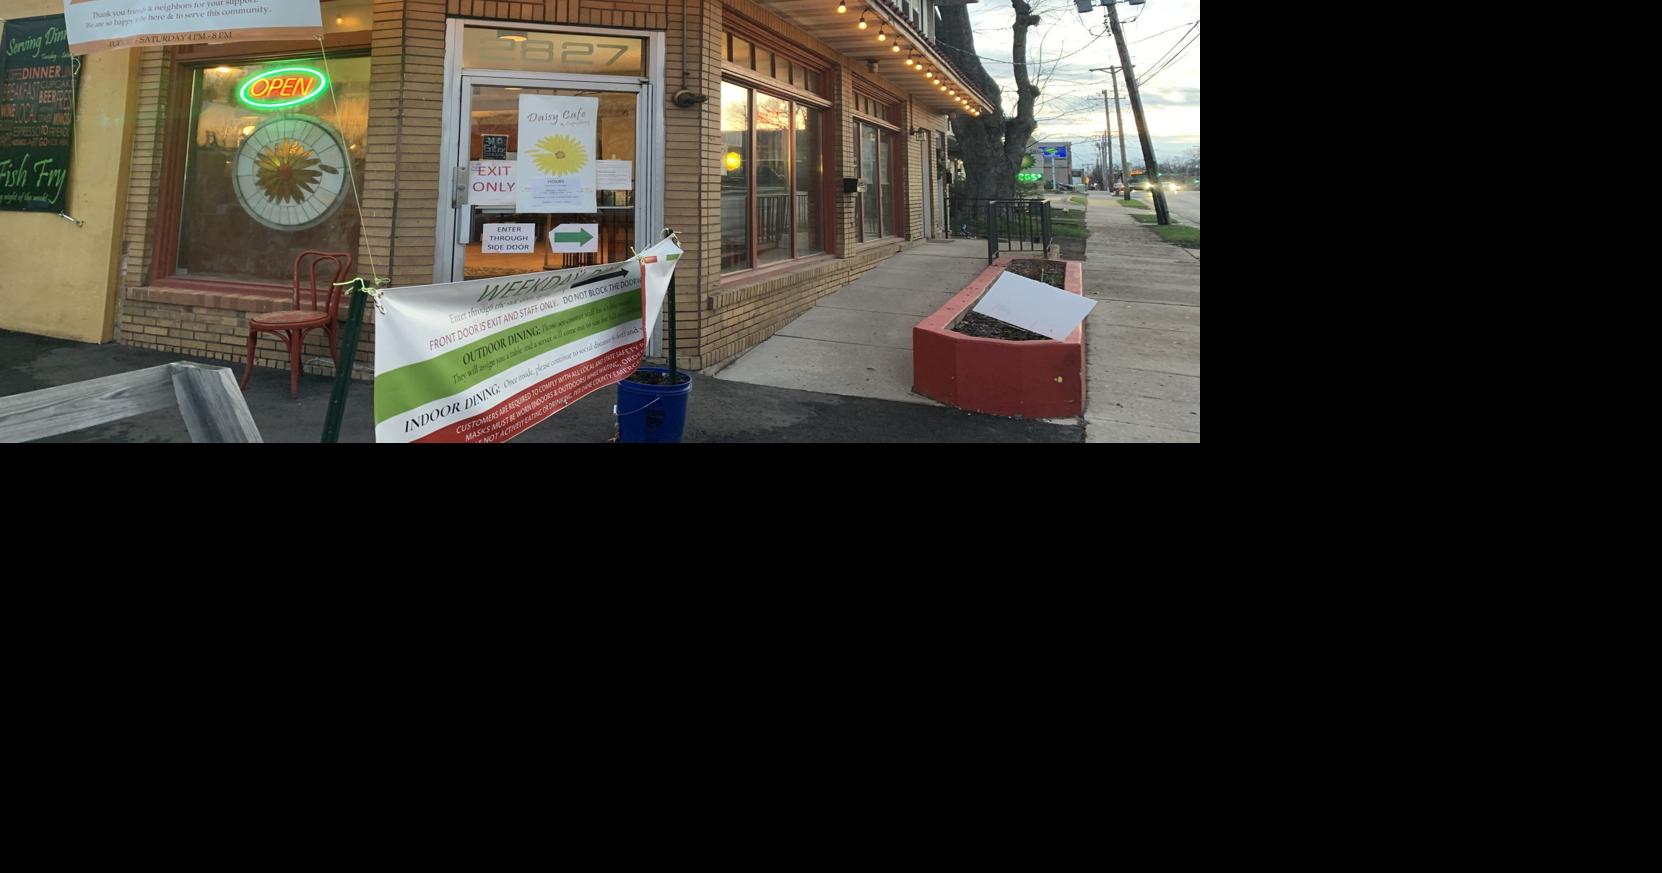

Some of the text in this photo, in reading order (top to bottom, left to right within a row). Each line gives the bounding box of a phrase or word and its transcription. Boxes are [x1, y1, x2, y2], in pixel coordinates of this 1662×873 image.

[148, 13, 166, 21] here
[184, 10, 205, 19] serve
[206, 8, 221, 17] this
[221, 5, 272, 16] community.
[154, 2, 192, 12] neighbors
[206, 0, 225, 8] your
[6, 35, 42, 58] Serving
[140, 34, 185, 43] SATURDAY
[480, 38, 629, 66] 2827
[22, 65, 62, 80] DINNER
[250, 76, 315, 98] OPEN
[527, 112, 559, 126] Daisy
[562, 106, 586, 121] Cafe
[0, 153, 66, 204] Fish Fry
[478, 166, 511, 177] EXIT
[472, 181, 515, 193] ONLY
[429, 332, 456, 351] FRONT
[457, 324, 479, 341] DOOR
[479, 322, 486, 332] IS
[486, 316, 502, 329] EXIT
[503, 311, 519, 322] AND
[520, 304, 538, 318] STAFF
[563, 295, 574, 304] DO
[574, 291, 588, 301] NOT
[588, 287, 608, 298] BLOCK
[609, 282, 619, 292] THE
[462, 338, 508, 365] OUTDOOR
[507, 325, 541, 345] DINING:
[404, 402, 460, 433] INDOOR
[464, 383, 501, 410] DINING:
[535, 361, 551, 377] please
[455, 410, 499, 434] CUSTOMERS
[499, 405, 509, 415] ARE
[508, 392, 532, 408] REQUIRED
[531, 388, 539, 396] TO
[539, 379, 559, 393] COMPLY
[558, 372, 571, 384] WITH
[571, 369, 581, 378] ALL
[580, 363, 595, 374] LOCAL
[483, 431, 498, 443] NOT
[500, 420, 525, 437] ACTIVELY
[524, 409, 543, 424] EATING
[592, 372, 612, 386] COUNTY
[465, 424, 491, 442] MASKS
[491, 417, 509, 432] MUST
[509, 413, 516, 422] BE
[516, 404, 532, 417] WORN
[531, 391, 554, 409] INDOORS
